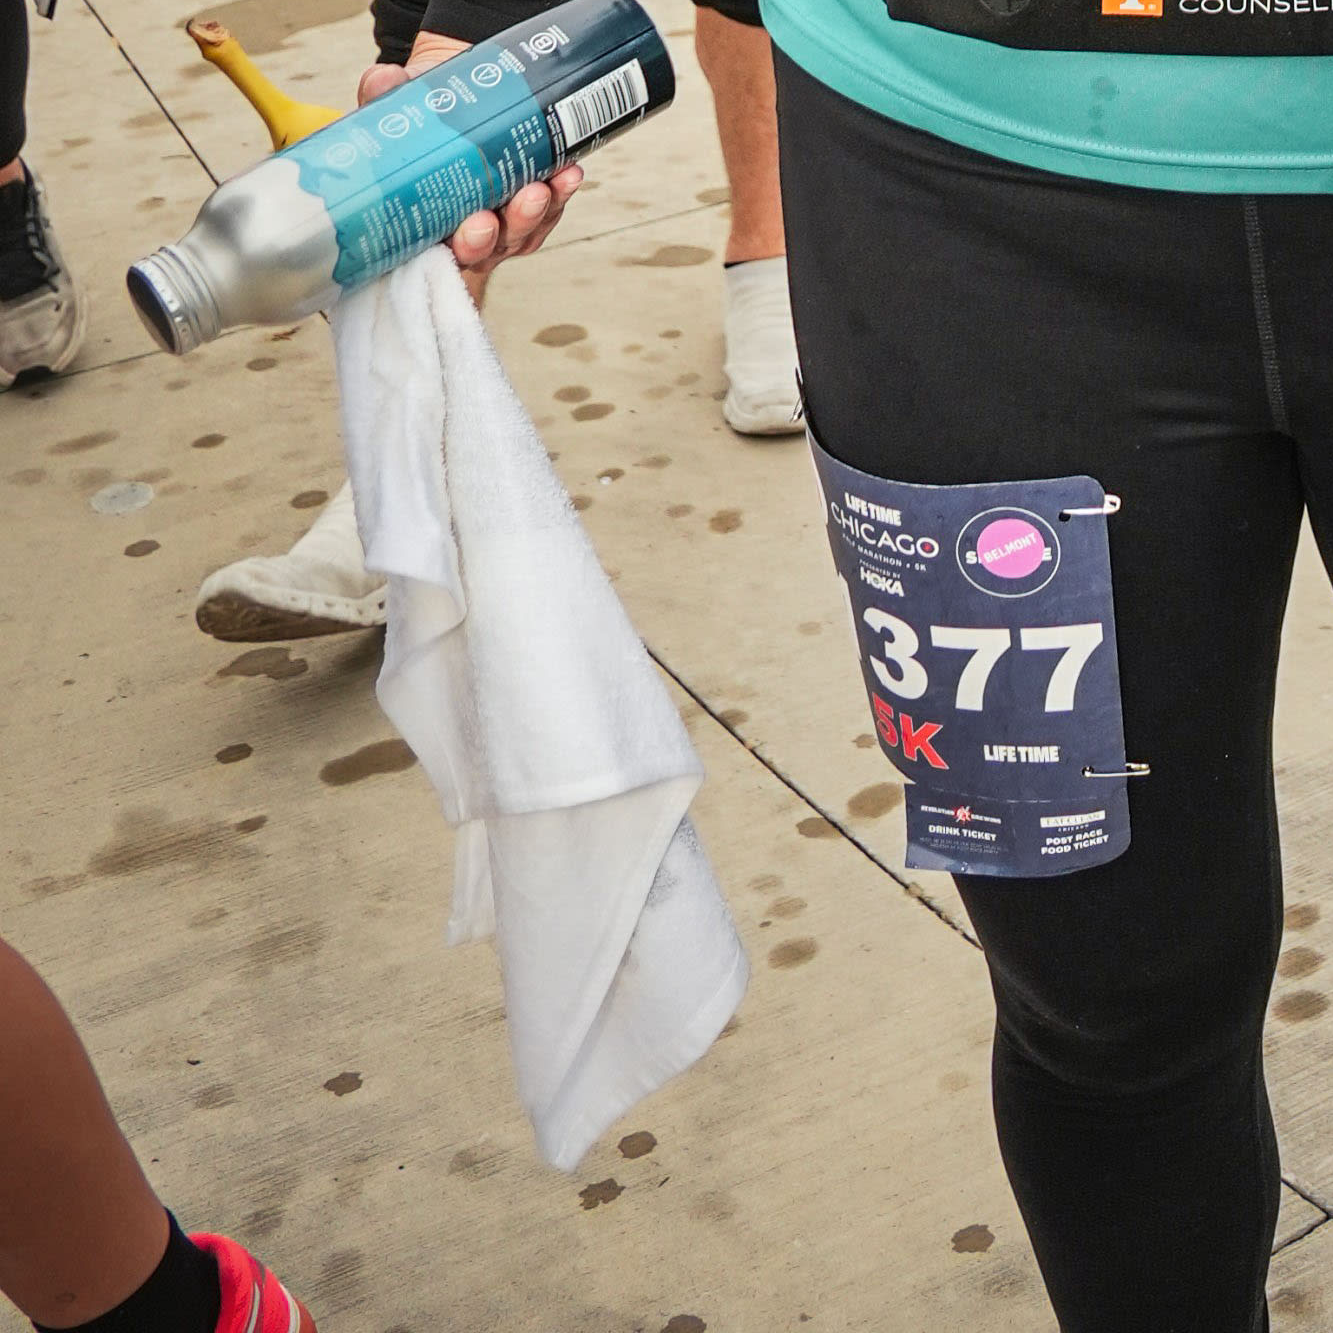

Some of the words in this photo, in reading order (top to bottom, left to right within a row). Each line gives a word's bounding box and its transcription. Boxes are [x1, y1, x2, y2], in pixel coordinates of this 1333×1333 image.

[831, 501, 940, 559] CHICAGO
[983, 532, 1038, 563] BELMONT
[860, 566, 905, 597] HOKA
[863, 606, 1104, 714] 377
[871, 692, 950, 770] 5K
[928, 824, 960, 836] DRINK
[961, 828, 997, 841] TICKET
[1041, 845, 1071, 855] FOOD
[1073, 834, 1109, 850] TICKET
[1046, 835, 1073, 845] POST
[1075, 828, 1103, 841] RACE
